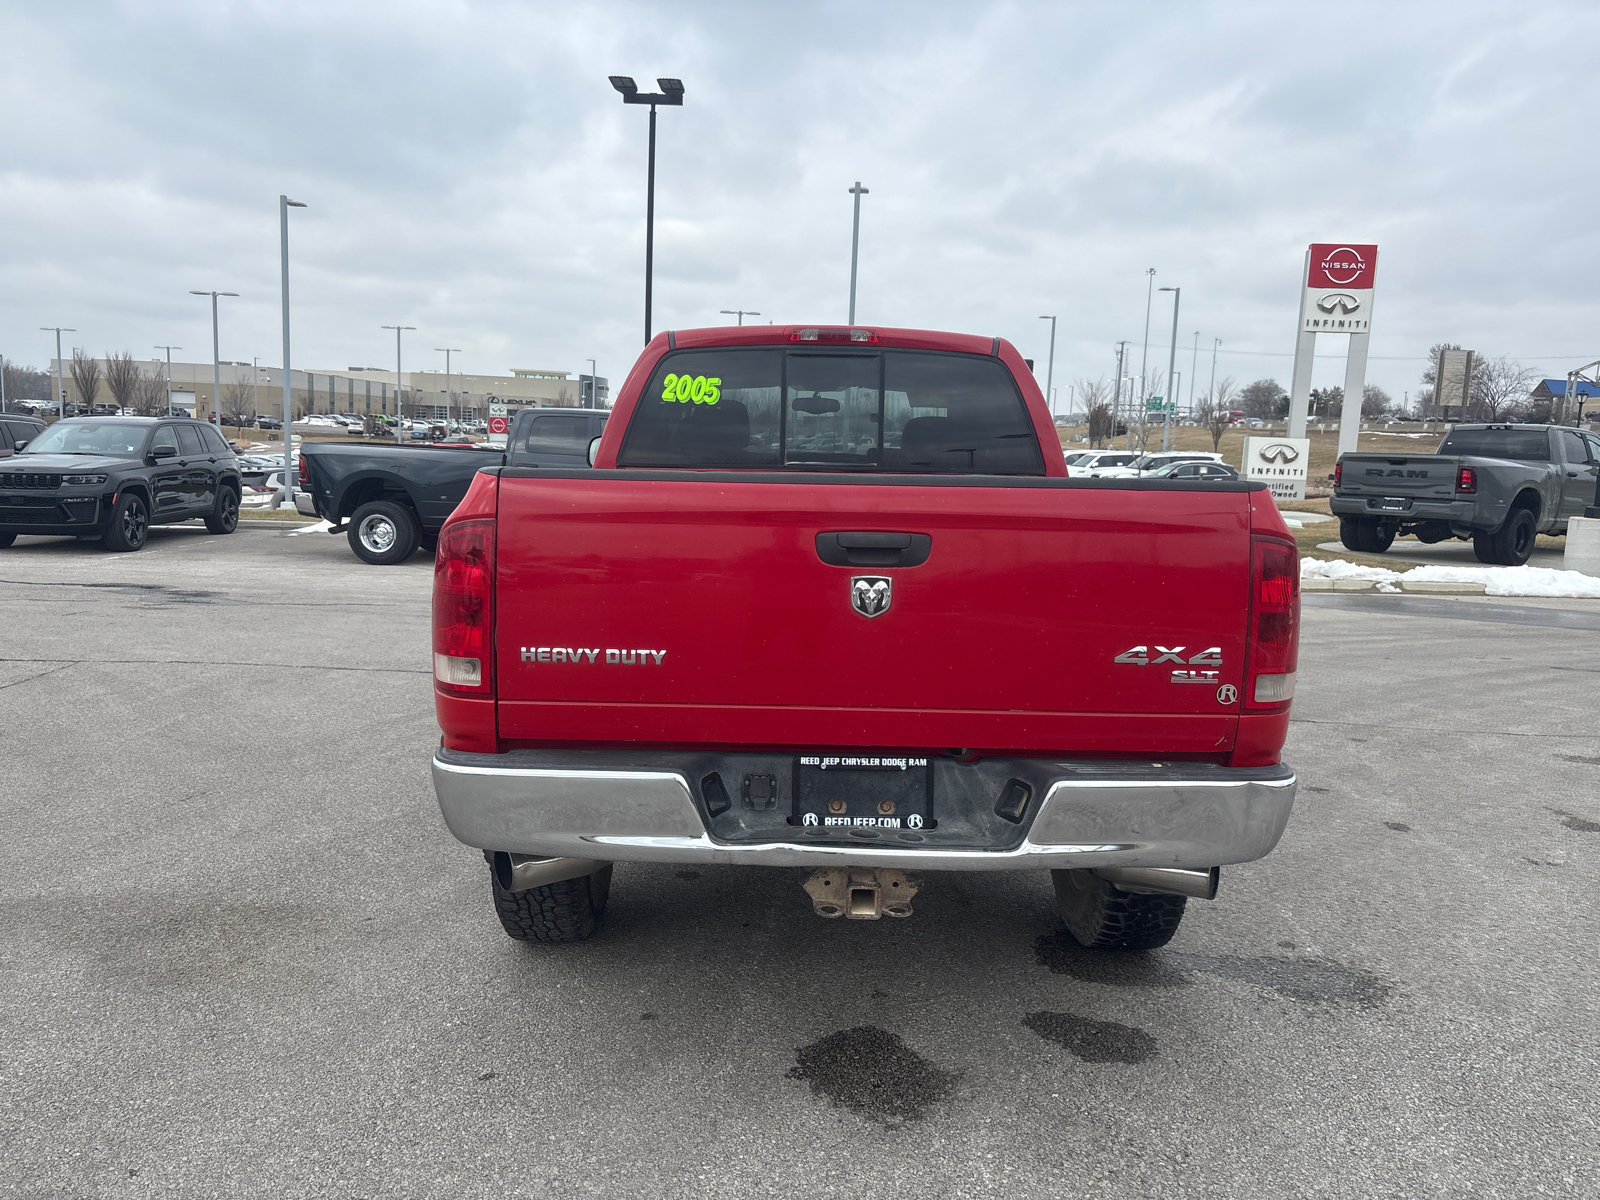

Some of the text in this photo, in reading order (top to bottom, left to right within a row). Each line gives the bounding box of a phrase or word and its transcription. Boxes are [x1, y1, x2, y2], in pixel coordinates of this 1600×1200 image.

[1306, 319, 1367, 328] INFINITI
[662, 373, 721, 405] 2005
[1252, 468, 1303, 476] INFINITI
[1365, 468, 1428, 479] RAM
[520, 647, 667, 665] HEAVY DUTY
[1171, 670, 1219, 681] SLT
[821, 757, 839, 765] JEEP
[842, 758, 880, 766] CHRYSLER
[881, 758, 907, 766] DODGE
[908, 758, 927, 766] RAM
